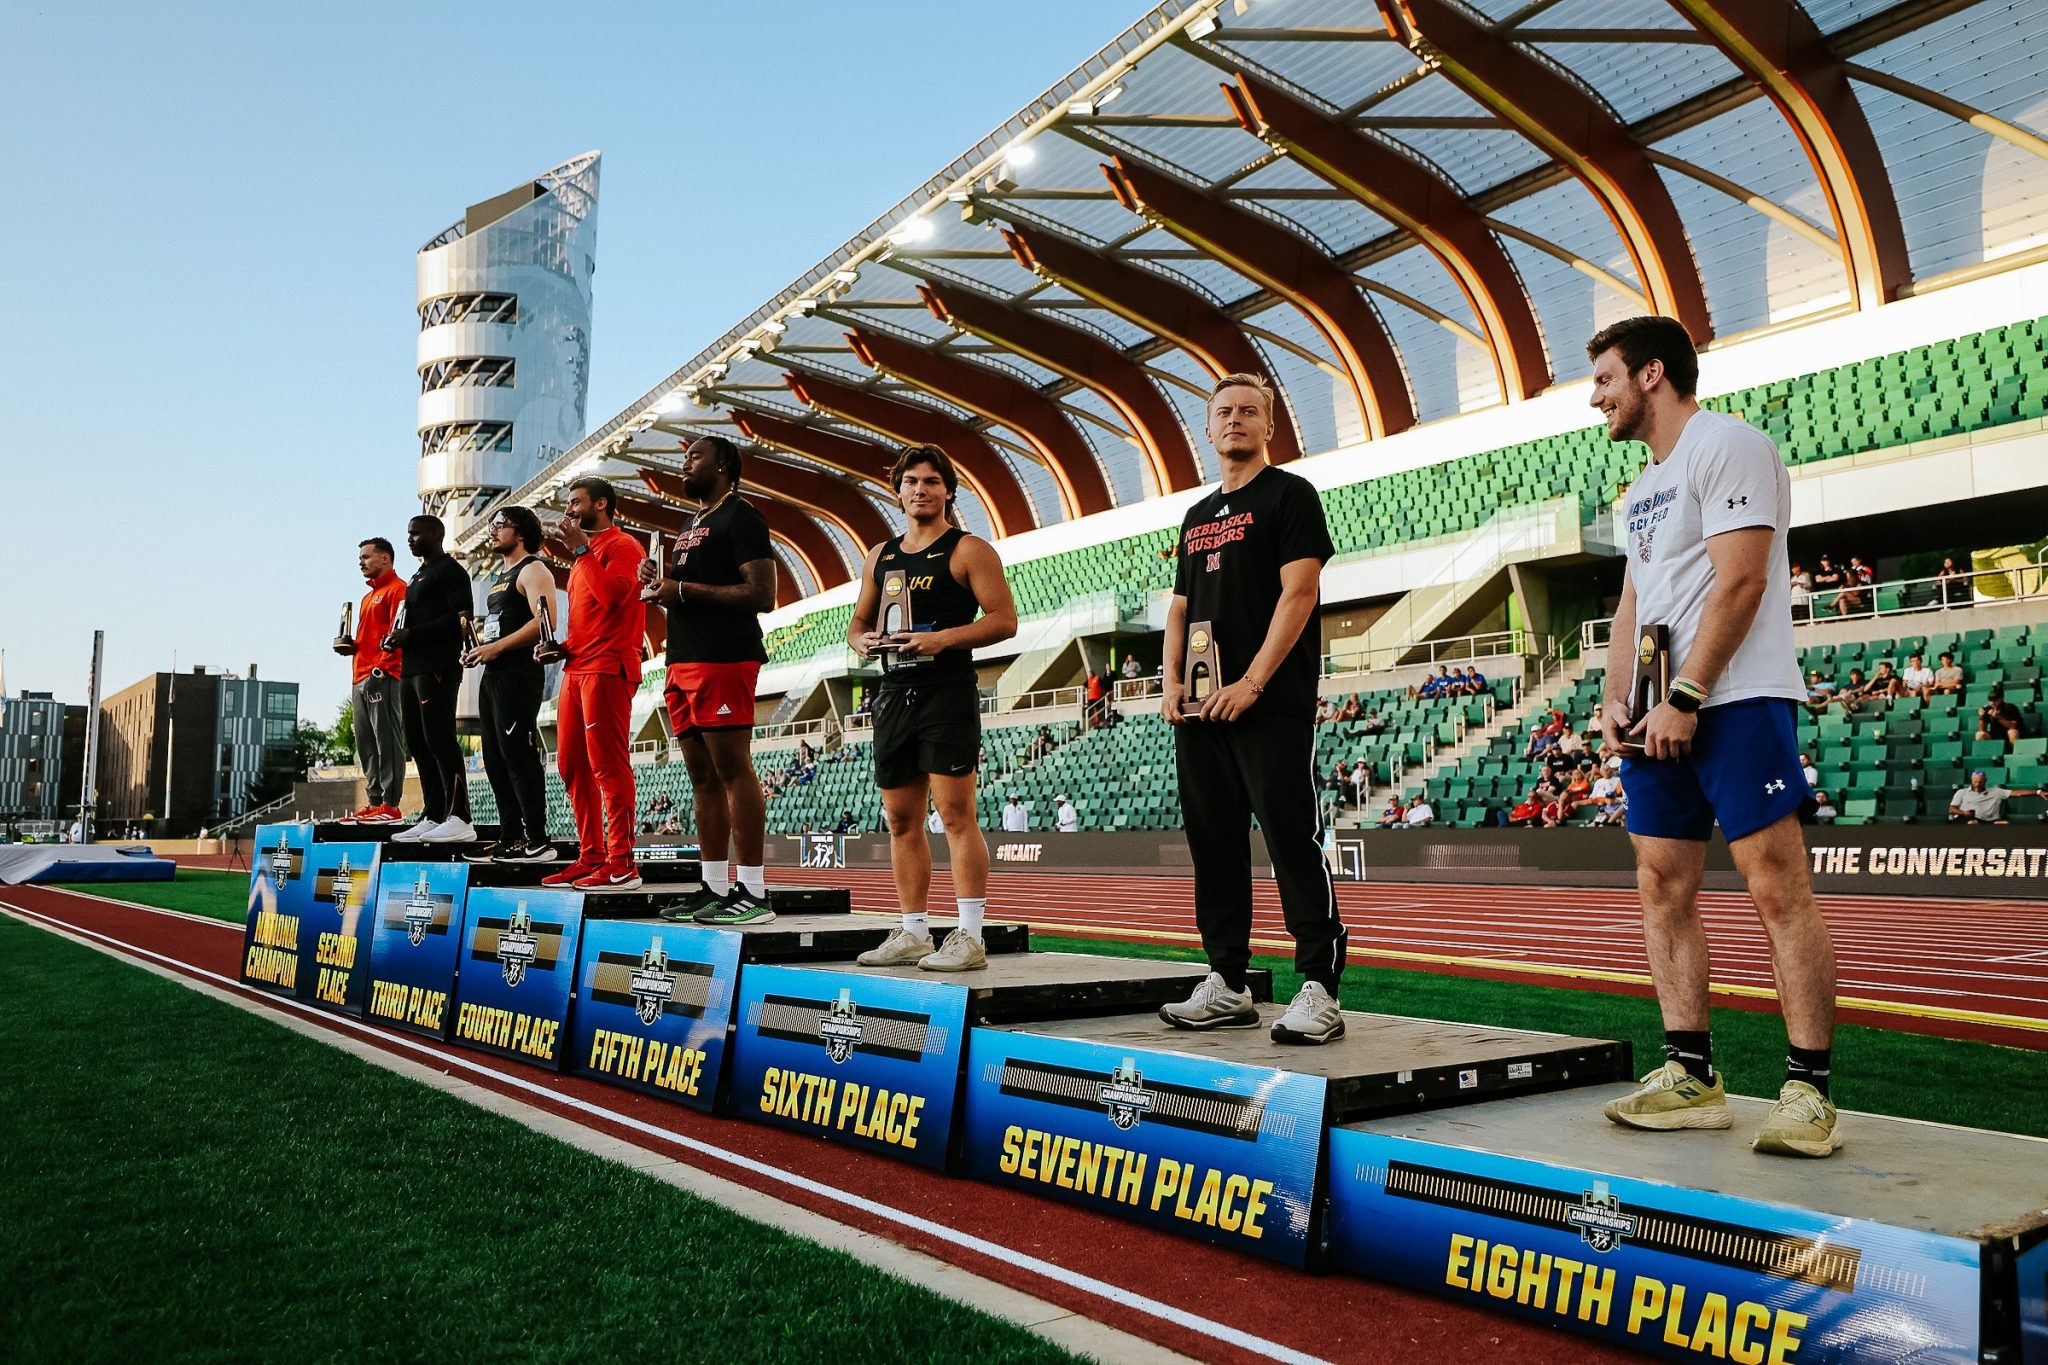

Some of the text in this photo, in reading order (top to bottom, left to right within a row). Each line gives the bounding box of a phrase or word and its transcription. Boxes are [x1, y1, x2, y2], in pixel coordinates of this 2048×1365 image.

[1185, 512, 1253, 543] NEBRASKA
[1187, 527, 1245, 556] HUSKERS
[1206, 552, 1220, 572] N
[996, 844, 1042, 861] #NCAATF
[1811, 847, 1861, 874] THE
[254, 911, 299, 950] NATIONAL
[246, 946, 298, 988] CHAMPION
[316, 932, 357, 969] SECOND
[316, 968, 349, 1005] PLACE
[370, 980, 446, 1030] THIRD PLACE
[456, 1002, 559, 1060] FOURTH PLACE
[589, 1029, 706, 1096] FIFTH PLACE
[760, 1067, 925, 1149] SIXTH PLACE
[1102, 1088, 1150, 1106] CHAMPIONSHIPS
[999, 1125, 1274, 1239] SEVENTH PLACE
[1571, 1210, 1631, 1231] CHAMPIONSHIPS
[1446, 1234, 1808, 1365] EIGHTH PLACE
